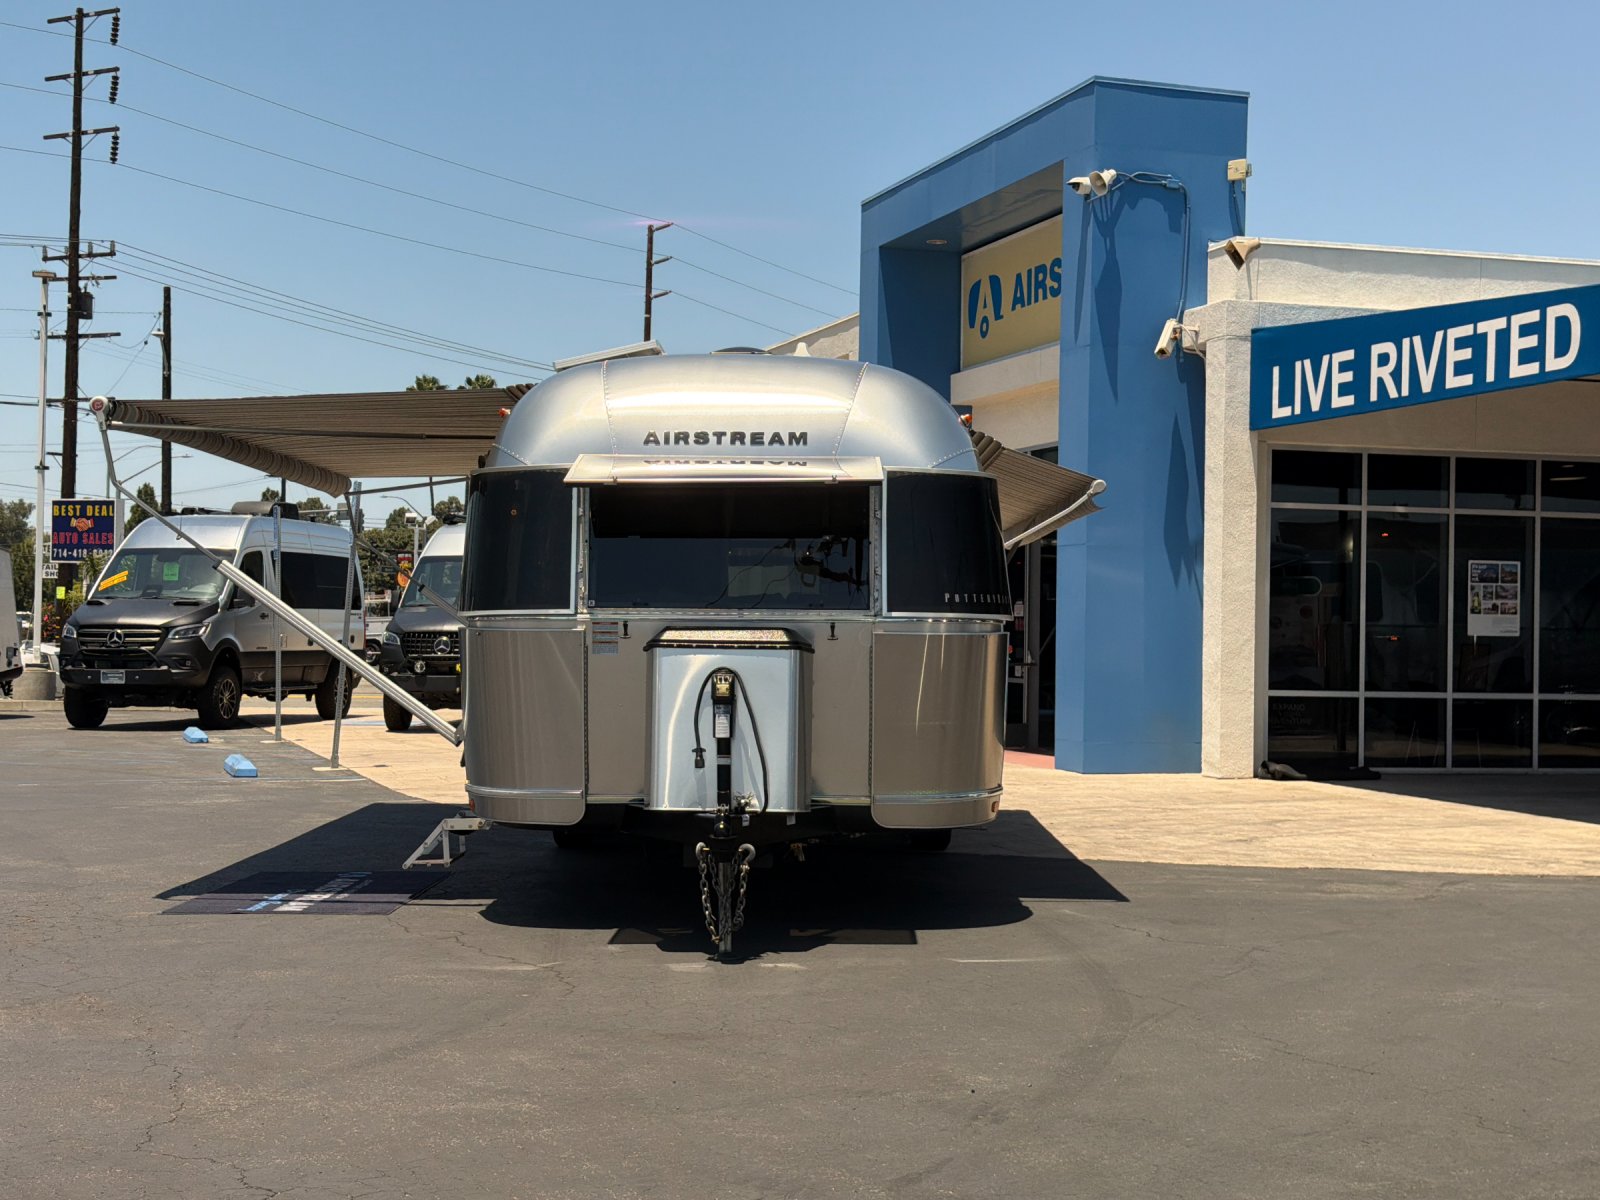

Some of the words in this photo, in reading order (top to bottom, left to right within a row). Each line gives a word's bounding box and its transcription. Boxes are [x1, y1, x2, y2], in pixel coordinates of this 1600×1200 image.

[1271, 349, 1355, 419] LIVE
[1369, 302, 1582, 402] RIVETED
[643, 431, 808, 446] AIRSTREAM
[53, 505, 81, 516] BEST
[86, 505, 114, 516] DEAL
[52, 532, 79, 545] AUTO
[82, 532, 114, 545] SALES
